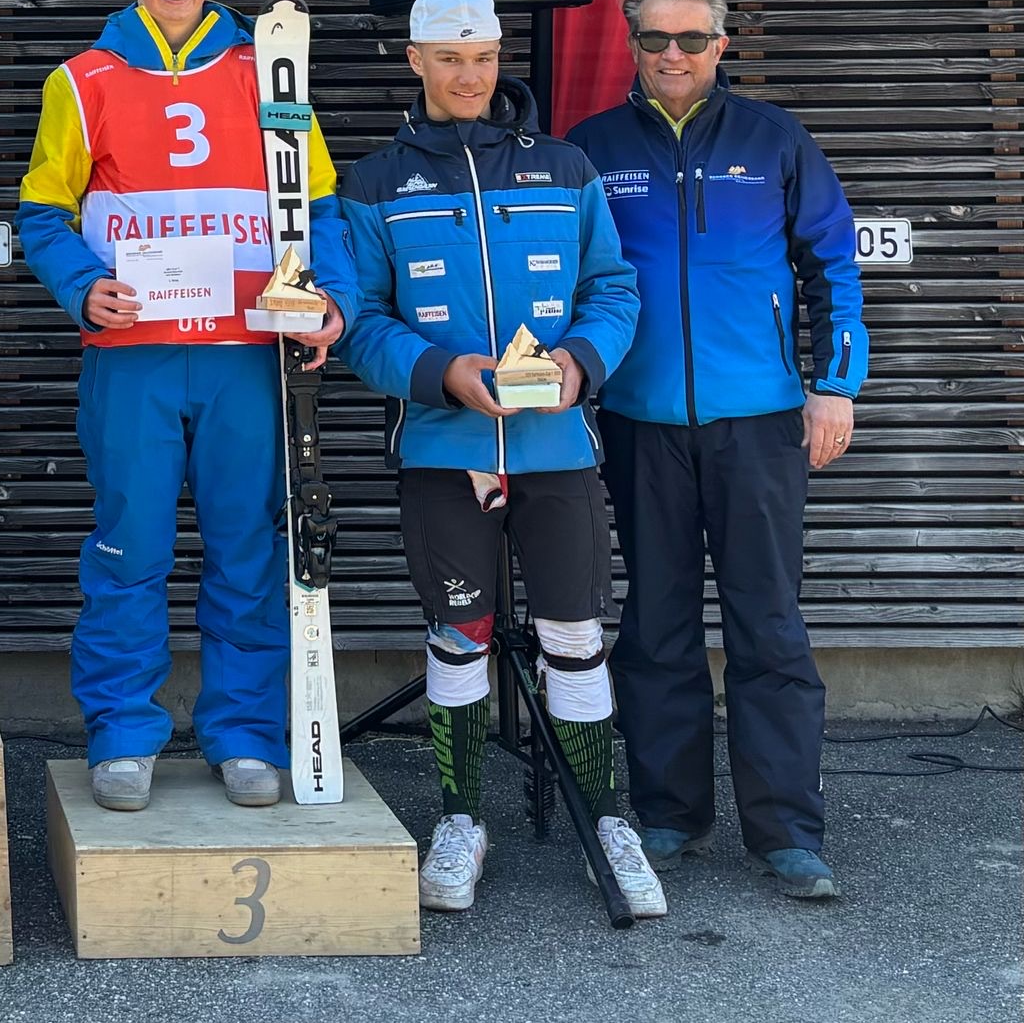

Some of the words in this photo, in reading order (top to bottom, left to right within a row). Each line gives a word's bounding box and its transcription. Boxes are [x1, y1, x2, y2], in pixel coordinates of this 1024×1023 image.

[267, 111, 311, 121] HEAD
[164, 102, 211, 167] 3
[602, 172, 650, 183] RAIFFEISEN
[612, 184, 649, 195] Sunrise
[857, 226, 898, 259] 05
[149, 287, 212, 301] RAIFFEISEN
[178, 317, 216, 332] U16
[311, 720, 324, 792] HEAD
[217, 857, 271, 945] 3
